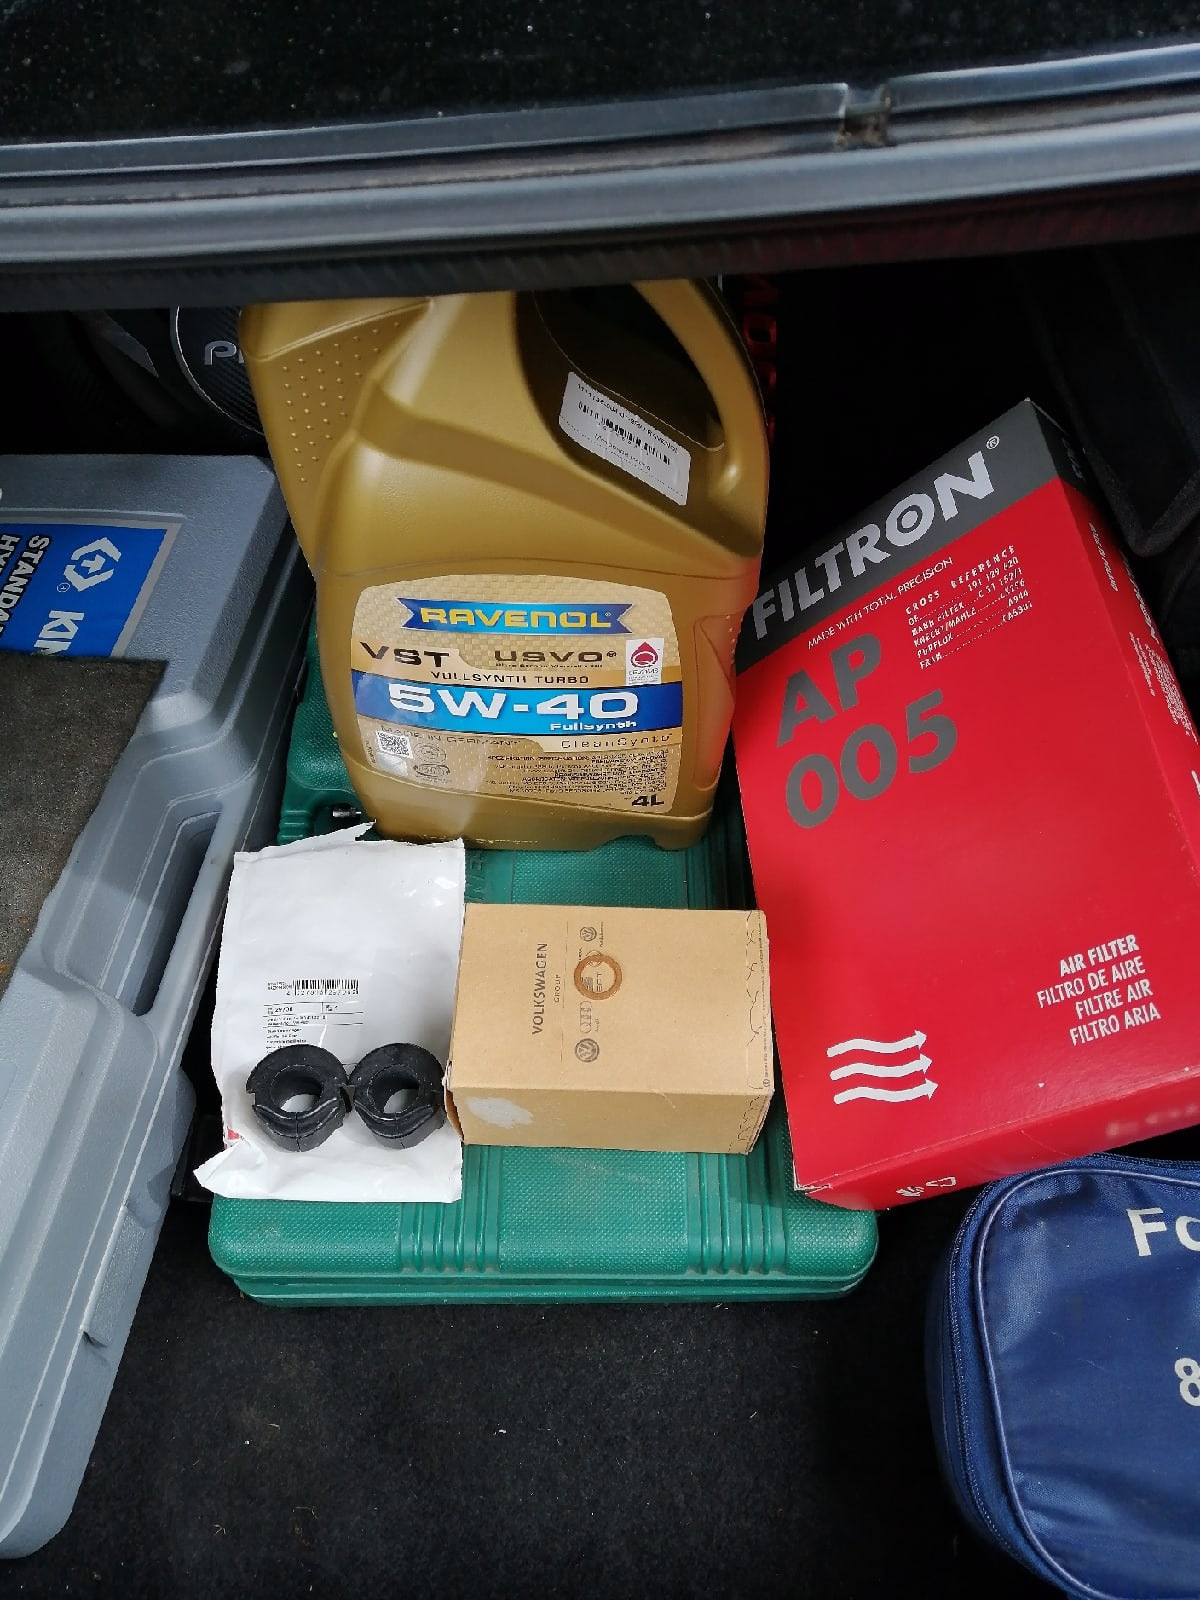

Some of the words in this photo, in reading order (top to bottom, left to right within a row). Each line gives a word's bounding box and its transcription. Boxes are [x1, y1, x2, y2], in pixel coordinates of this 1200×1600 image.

[808, 626, 835, 650] MADE
[897, 557, 953, 595] PRECISION
[360, 641, 450, 668] VST
[534, 675, 589, 684] TURBO
[776, 633, 881, 748] AP
[388, 683, 639, 720] 5W-40
[550, 720, 637, 732] Fullsynth
[786, 688, 957, 828] 005
[631, 794, 665, 807] 4L
[1060, 953, 1086, 977] AIR
[1088, 934, 1139, 966] FILTER
[532, 943, 548, 1035] VOLKSWAGEN
[1036, 978, 1084, 1008] FILTRO
[1088, 969, 1109, 990] DE
[1111, 955, 1146, 983] AIRE
[1075, 988, 1123, 1020] FILTRE
[1127, 979, 1153, 1003] AIR
[1069, 1014, 1120, 1046] FILTRO
[1124, 1002, 1161, 1029] ARIA
